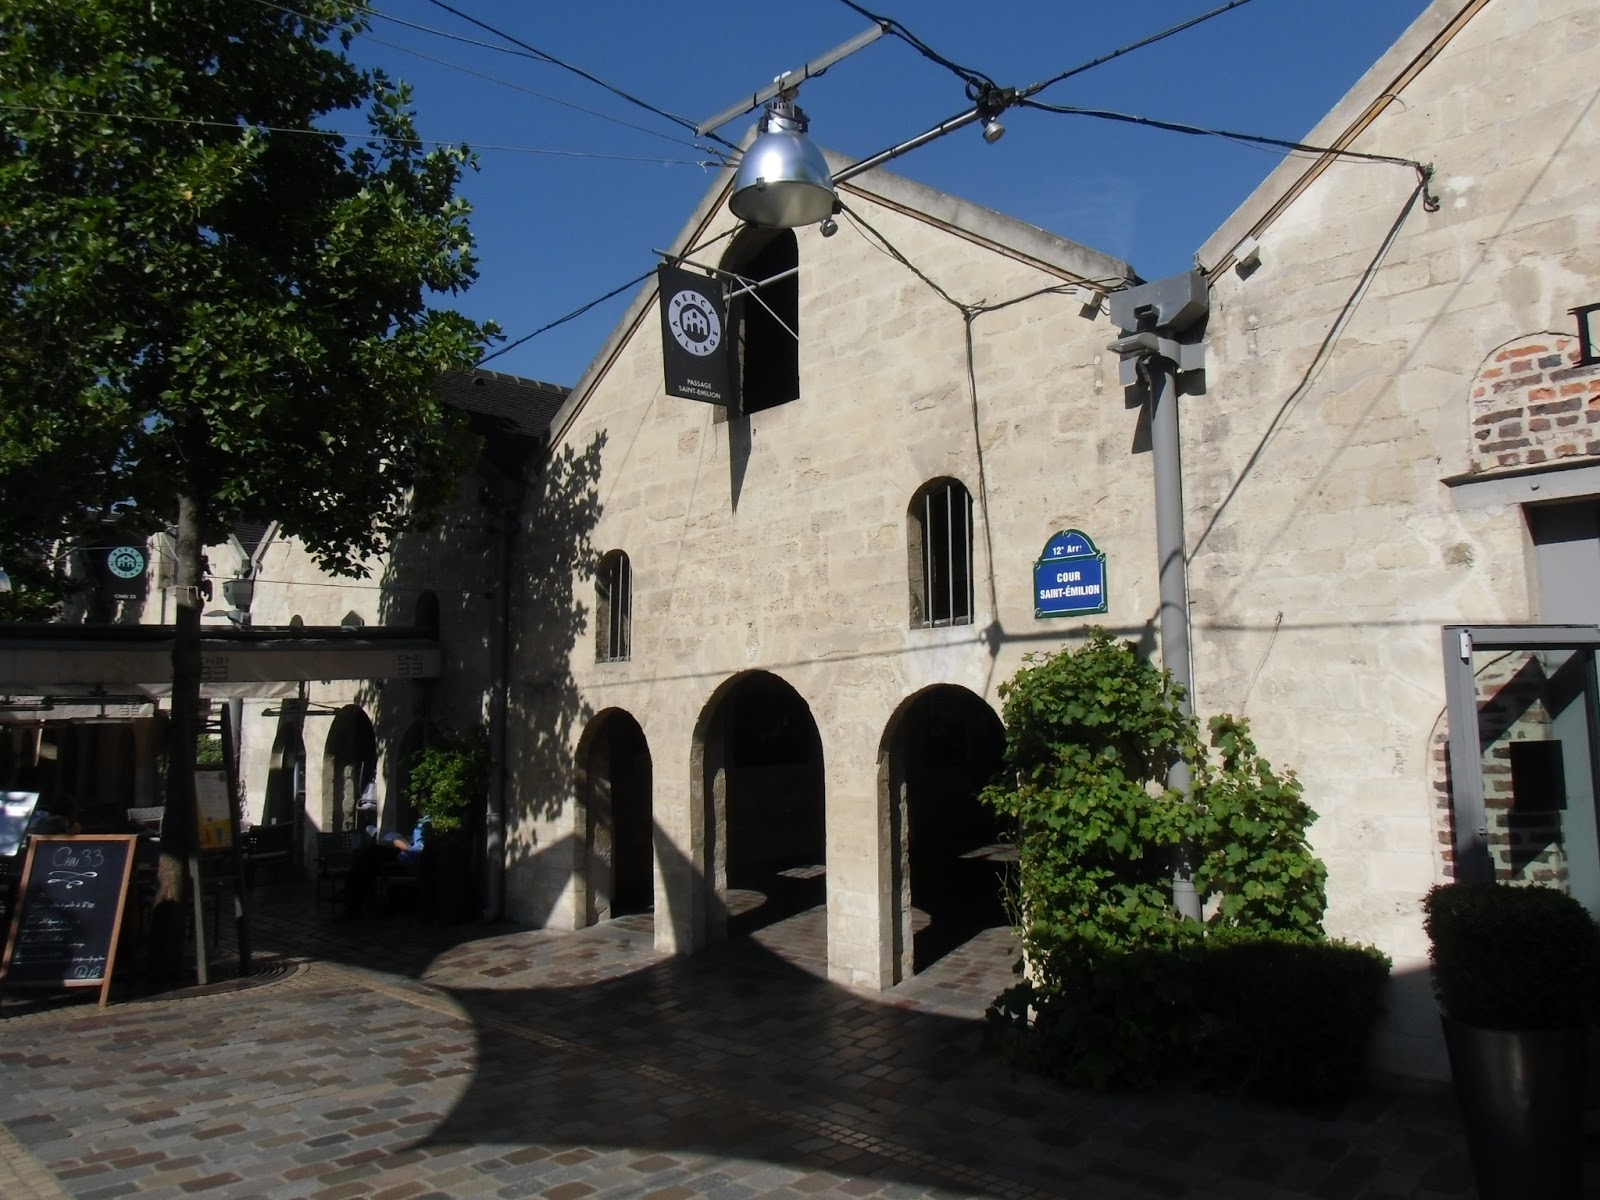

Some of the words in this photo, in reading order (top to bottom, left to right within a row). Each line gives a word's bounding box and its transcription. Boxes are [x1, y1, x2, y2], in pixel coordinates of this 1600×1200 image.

[674, 294, 714, 315] BERCY
[672, 320, 718, 353] VILLAGE
[686, 378, 712, 390] PASSAGE
[678, 385, 721, 400] SAINT-EMILION
[1056, 571, 1081, 583] COUR
[1039, 584, 1100, 600] SAINT-ÉMILION
[398, 662, 424, 676] 33
[82, 848, 104, 868] 33
